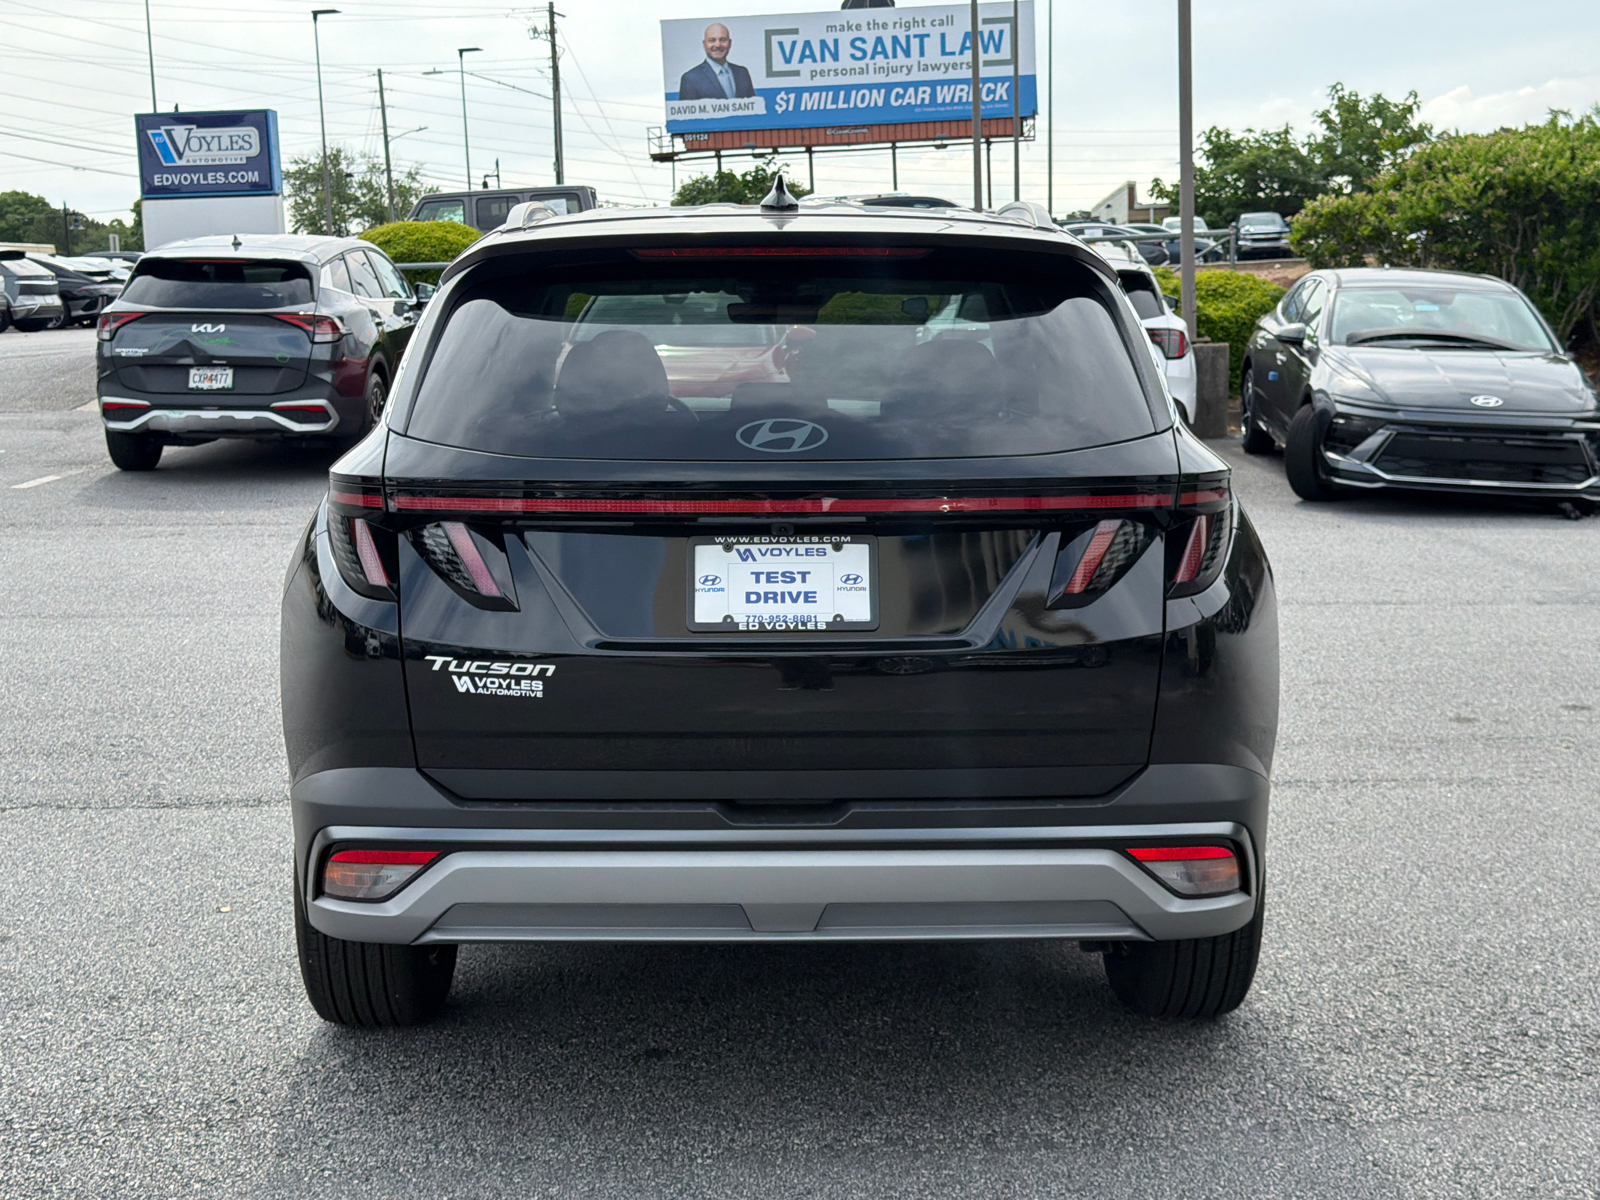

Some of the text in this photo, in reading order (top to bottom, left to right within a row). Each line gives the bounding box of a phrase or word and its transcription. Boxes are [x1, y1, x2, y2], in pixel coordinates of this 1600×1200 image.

[826, 14, 954, 33] make the right call
[777, 29, 1004, 64] VAN SANT LAW
[810, 60, 972, 81] personal injury lawyers
[774, 90, 796, 114] $1
[801, 88, 886, 111] MILLION
[890, 86, 931, 107] CAR
[670, 102, 755, 115] DAVID M. VAN SANT
[164, 127, 253, 161] VOYLES
[153, 171, 259, 186] EDVOYLES.COM
[757, 548, 827, 557] VOYLES
[750, 571, 811, 584] TEST
[745, 591, 817, 604] DRIVE
[739, 622, 827, 630] ED VOYLES
[474, 677, 543, 691] VOYLES
[476, 688, 543, 698] AUTOMOTIVE
